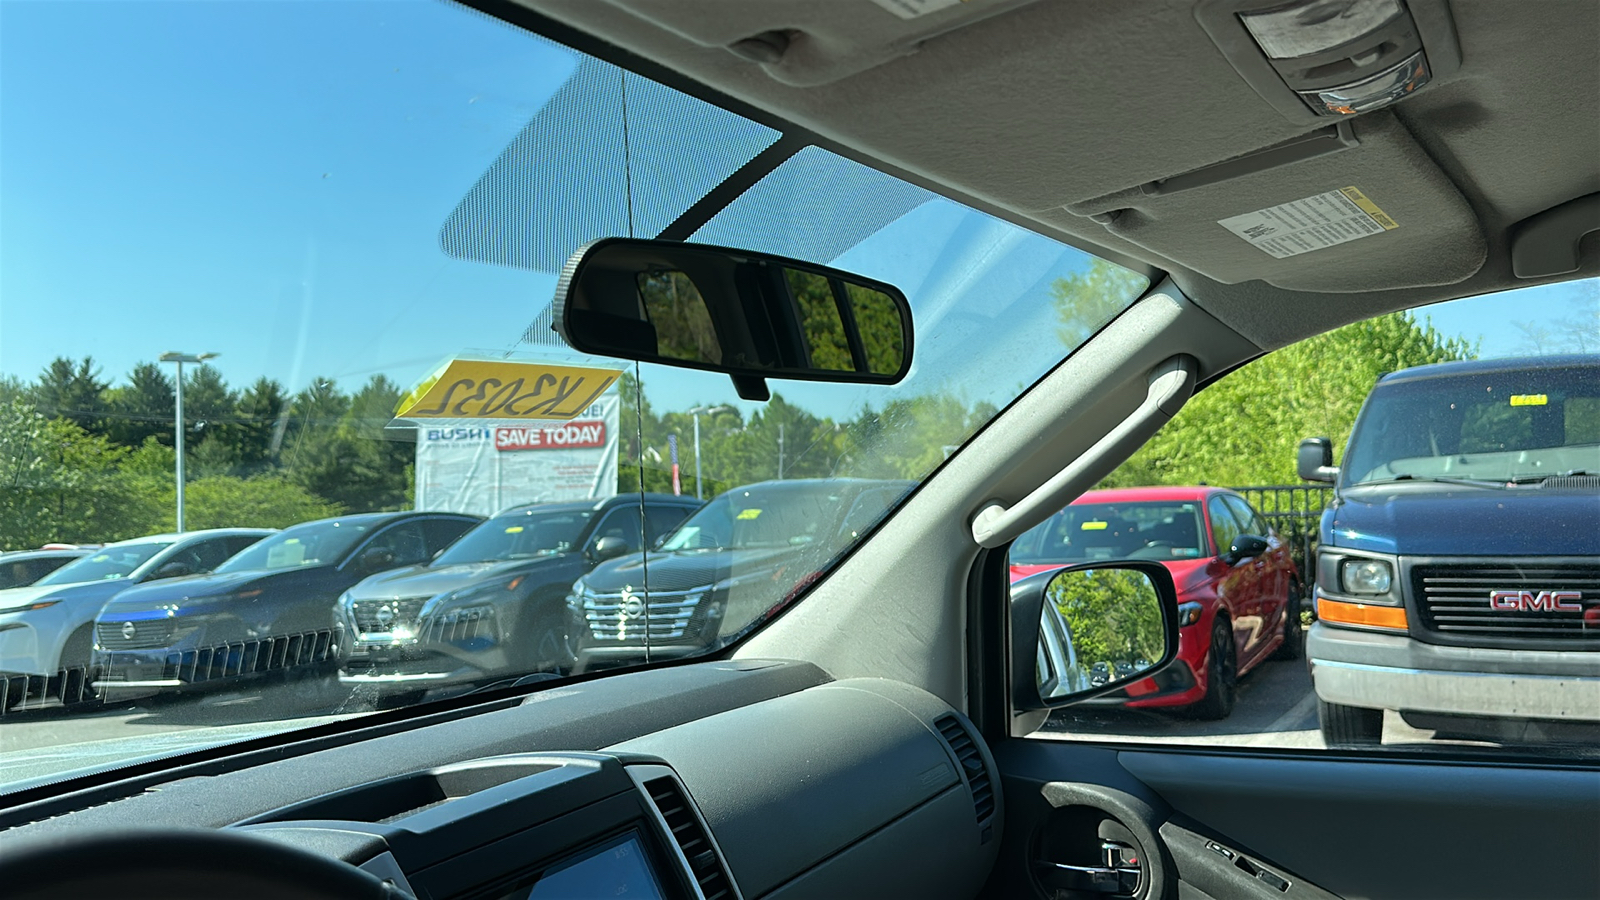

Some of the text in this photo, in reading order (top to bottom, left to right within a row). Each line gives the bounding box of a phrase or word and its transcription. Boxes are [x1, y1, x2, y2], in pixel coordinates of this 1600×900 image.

[497, 425, 603, 448] SAVE TODAY
[1490, 590, 1582, 612] GMC
